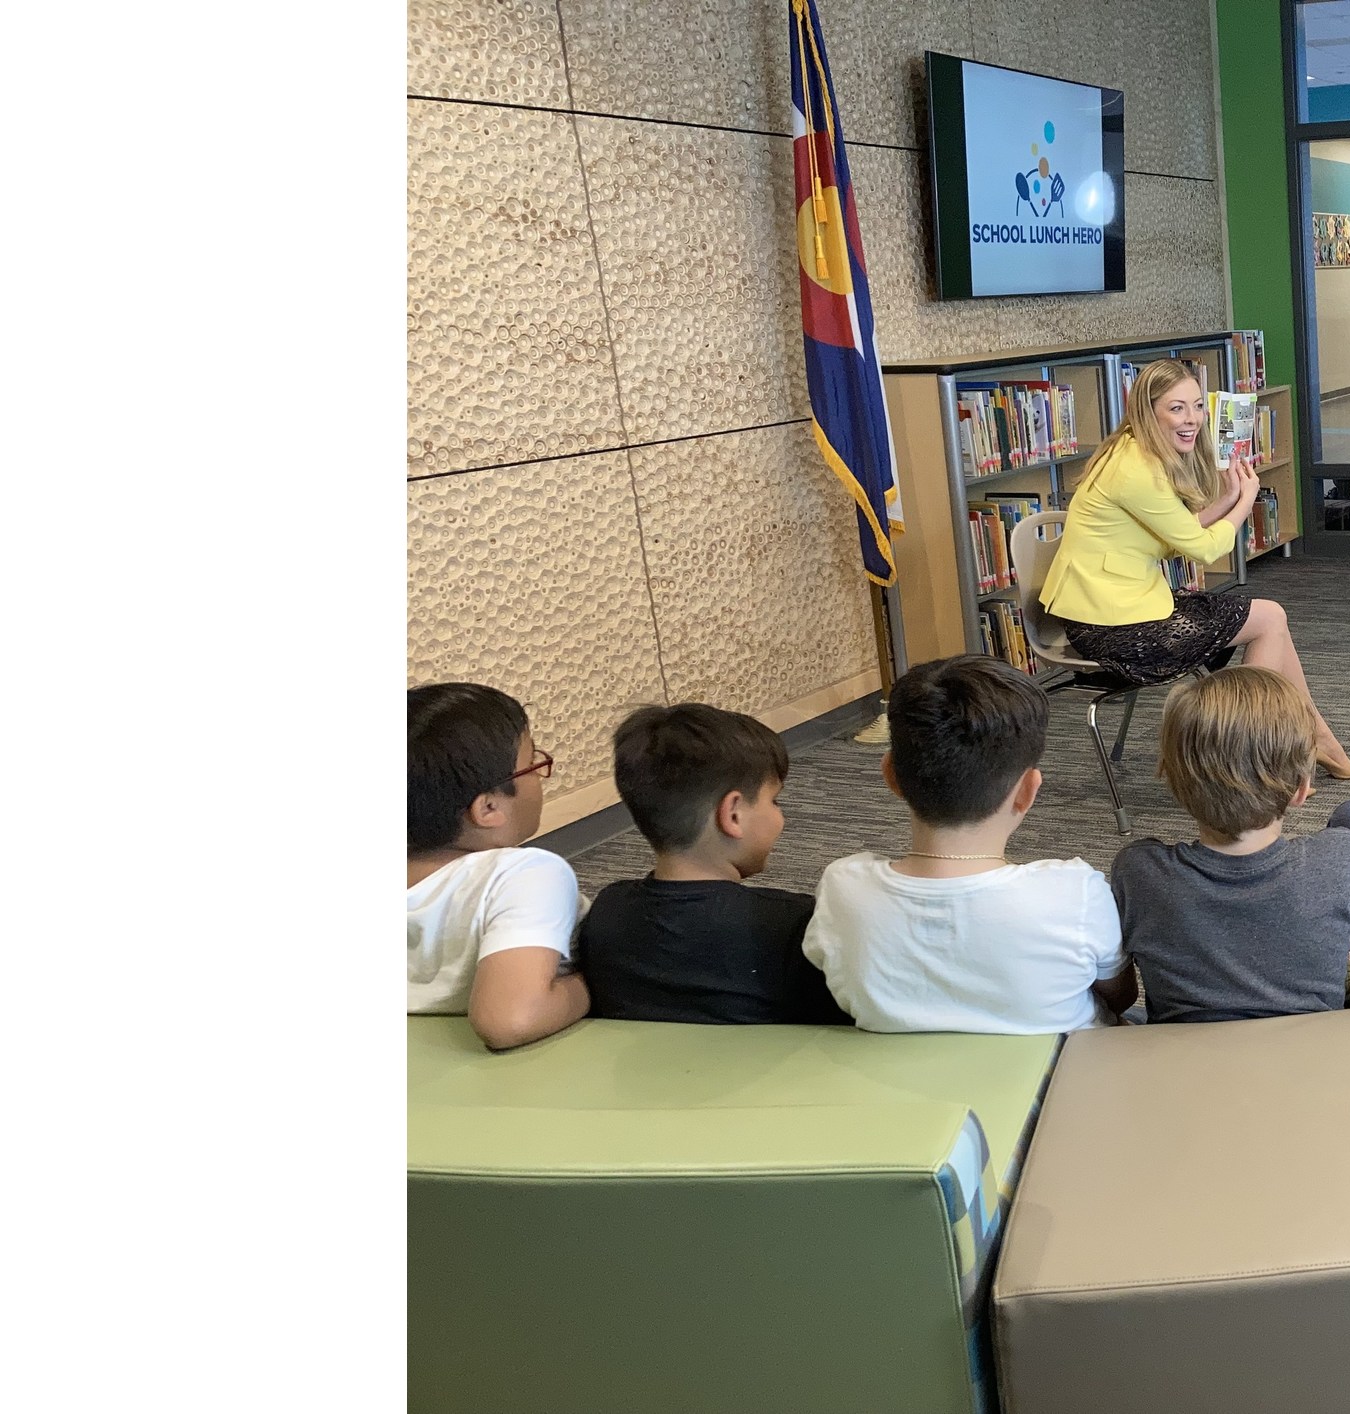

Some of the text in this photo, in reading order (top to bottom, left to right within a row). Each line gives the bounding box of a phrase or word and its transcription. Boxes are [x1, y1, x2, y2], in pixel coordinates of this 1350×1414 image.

[972, 224, 1102, 244] SCHOOL LUNCH HERO
